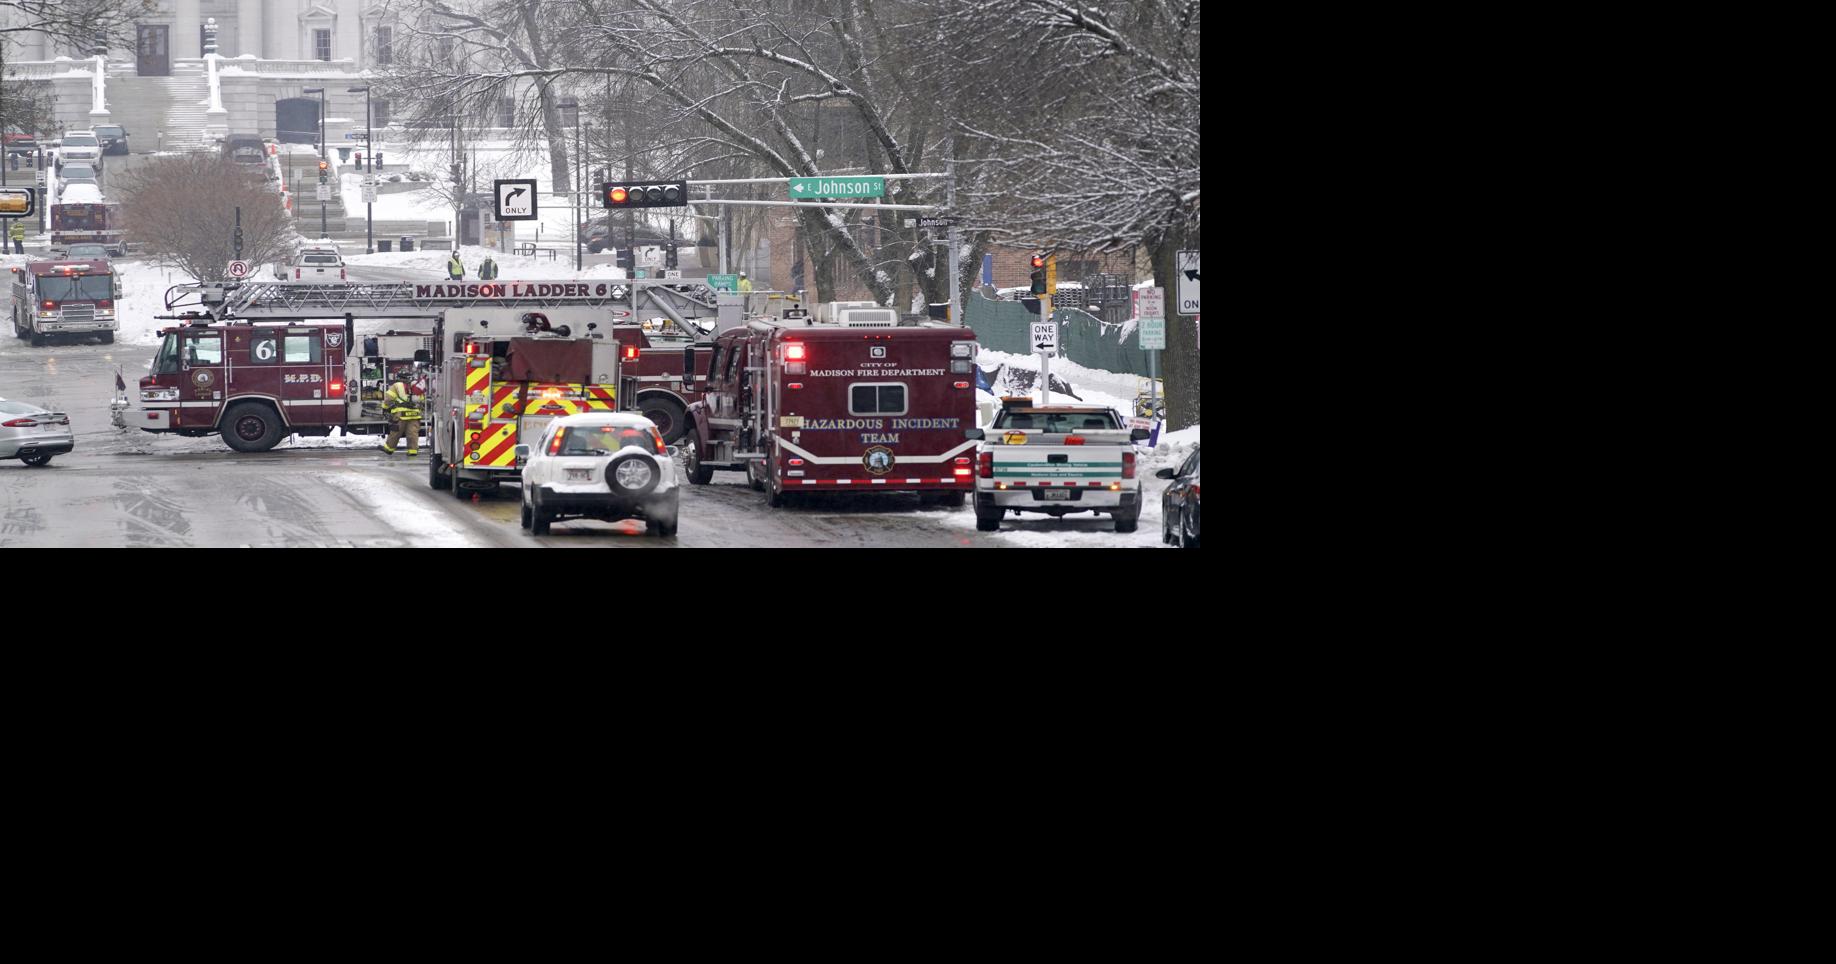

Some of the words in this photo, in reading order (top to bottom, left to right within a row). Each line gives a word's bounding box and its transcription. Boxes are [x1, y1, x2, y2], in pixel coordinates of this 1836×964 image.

[808, 183, 813, 192] E
[815, 180, 871, 195] Johnson
[874, 182, 882, 191] St
[919, 218, 948, 227] Johnson
[416, 284, 506, 298] MADISON
[512, 283, 591, 298] LADDER
[595, 283, 608, 297] 6
[1034, 325, 1054, 333] ONE
[1034, 334, 1054, 342] WAY
[255, 339, 272, 360] 6
[810, 369, 855, 377] MADISON
[857, 369, 880, 377] FIRE
[881, 368, 946, 377] DEPARTMENT
[800, 418, 884, 430] HAZARDOUS
[892, 418, 960, 429] INCIDENT
[860, 433, 900, 444] TEAM
